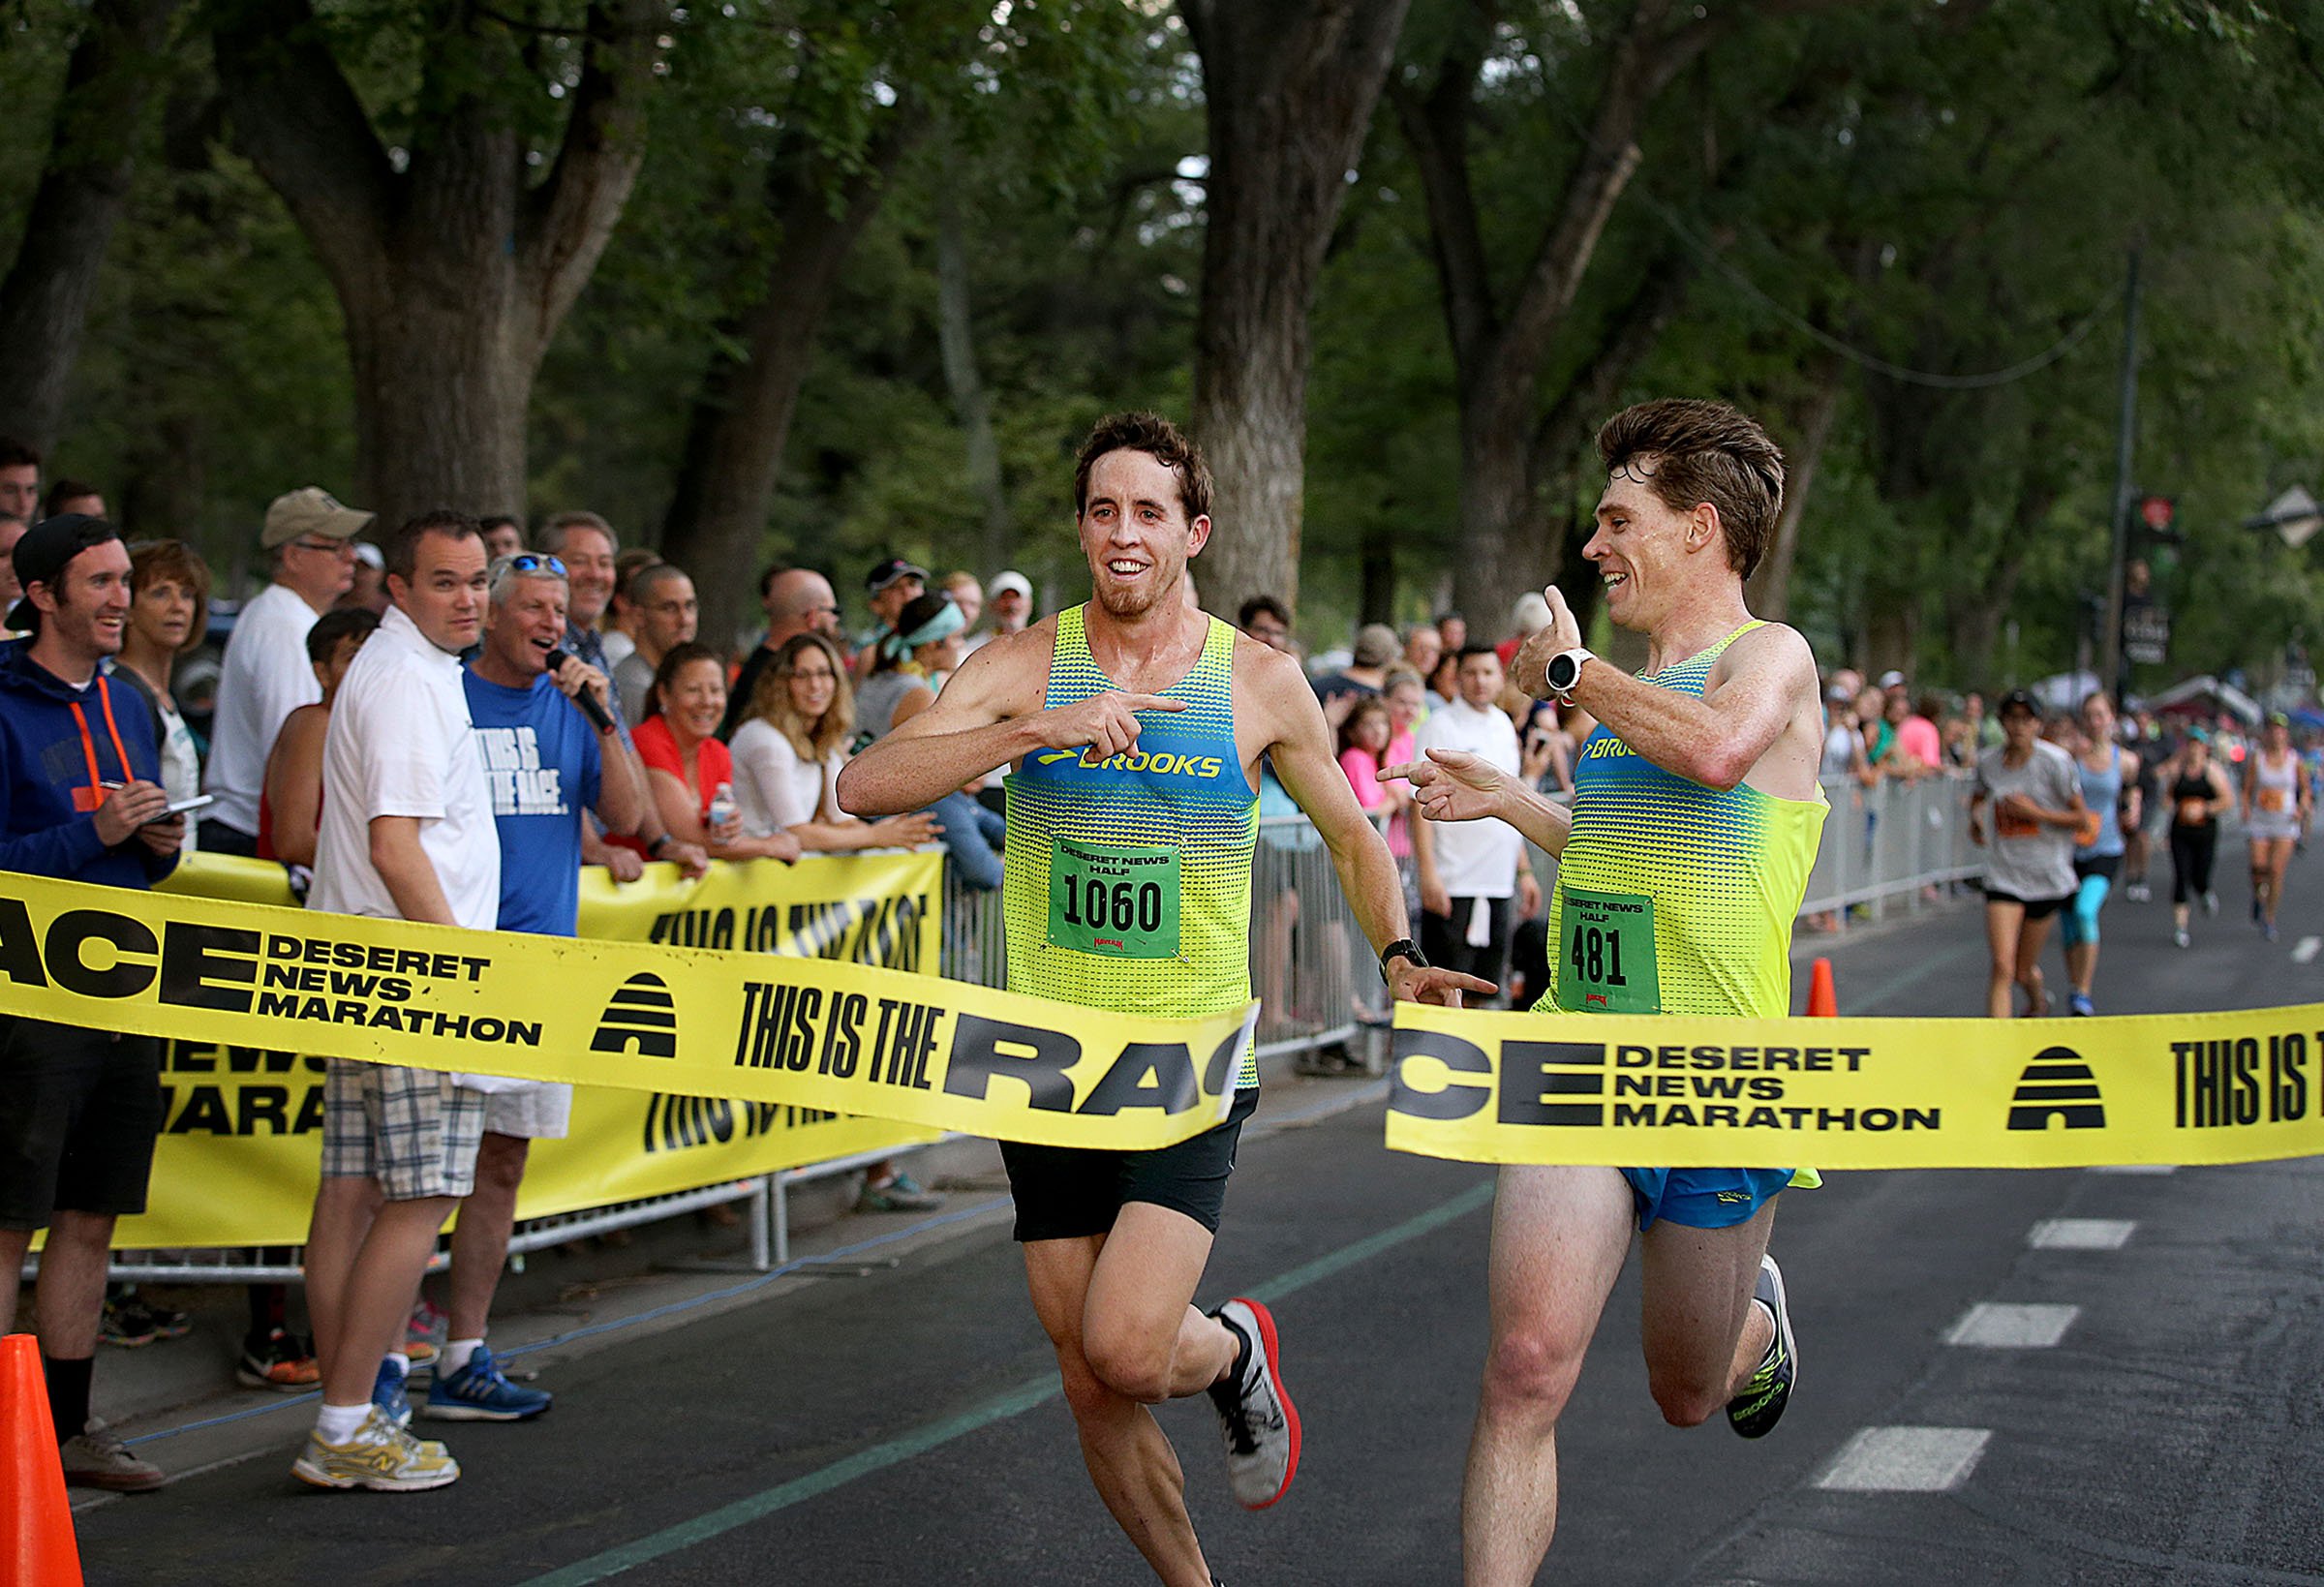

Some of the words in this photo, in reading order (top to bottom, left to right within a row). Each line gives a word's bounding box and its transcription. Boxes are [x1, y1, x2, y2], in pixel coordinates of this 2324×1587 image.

[1060, 845, 1119, 865] DESERET
[1121, 856, 1170, 866] NEWS
[1089, 865, 1130, 875] HALF
[1063, 873, 1161, 931] 1060
[1579, 911, 1609, 922] HALF
[1603, 902, 1643, 913] NEWS
[267, 934, 491, 981] DESERET
[1572, 925, 1627, 986] 481
[263, 963, 412, 1002] NEWS
[257, 989, 543, 1047] MARATHON
[735, 982, 822, 1072] THIS
[818, 992, 868, 1079] IS
[869, 998, 945, 1090] THE
[1390, 1027, 1607, 1126] CE
[1615, 1046, 1871, 1071] DESERET
[1614, 1075, 1785, 1100] NEWS
[2170, 1038, 2259, 1128] THIS
[2269, 1033, 2307, 1122] IS
[1613, 1104, 1941, 1131] MARATHON
